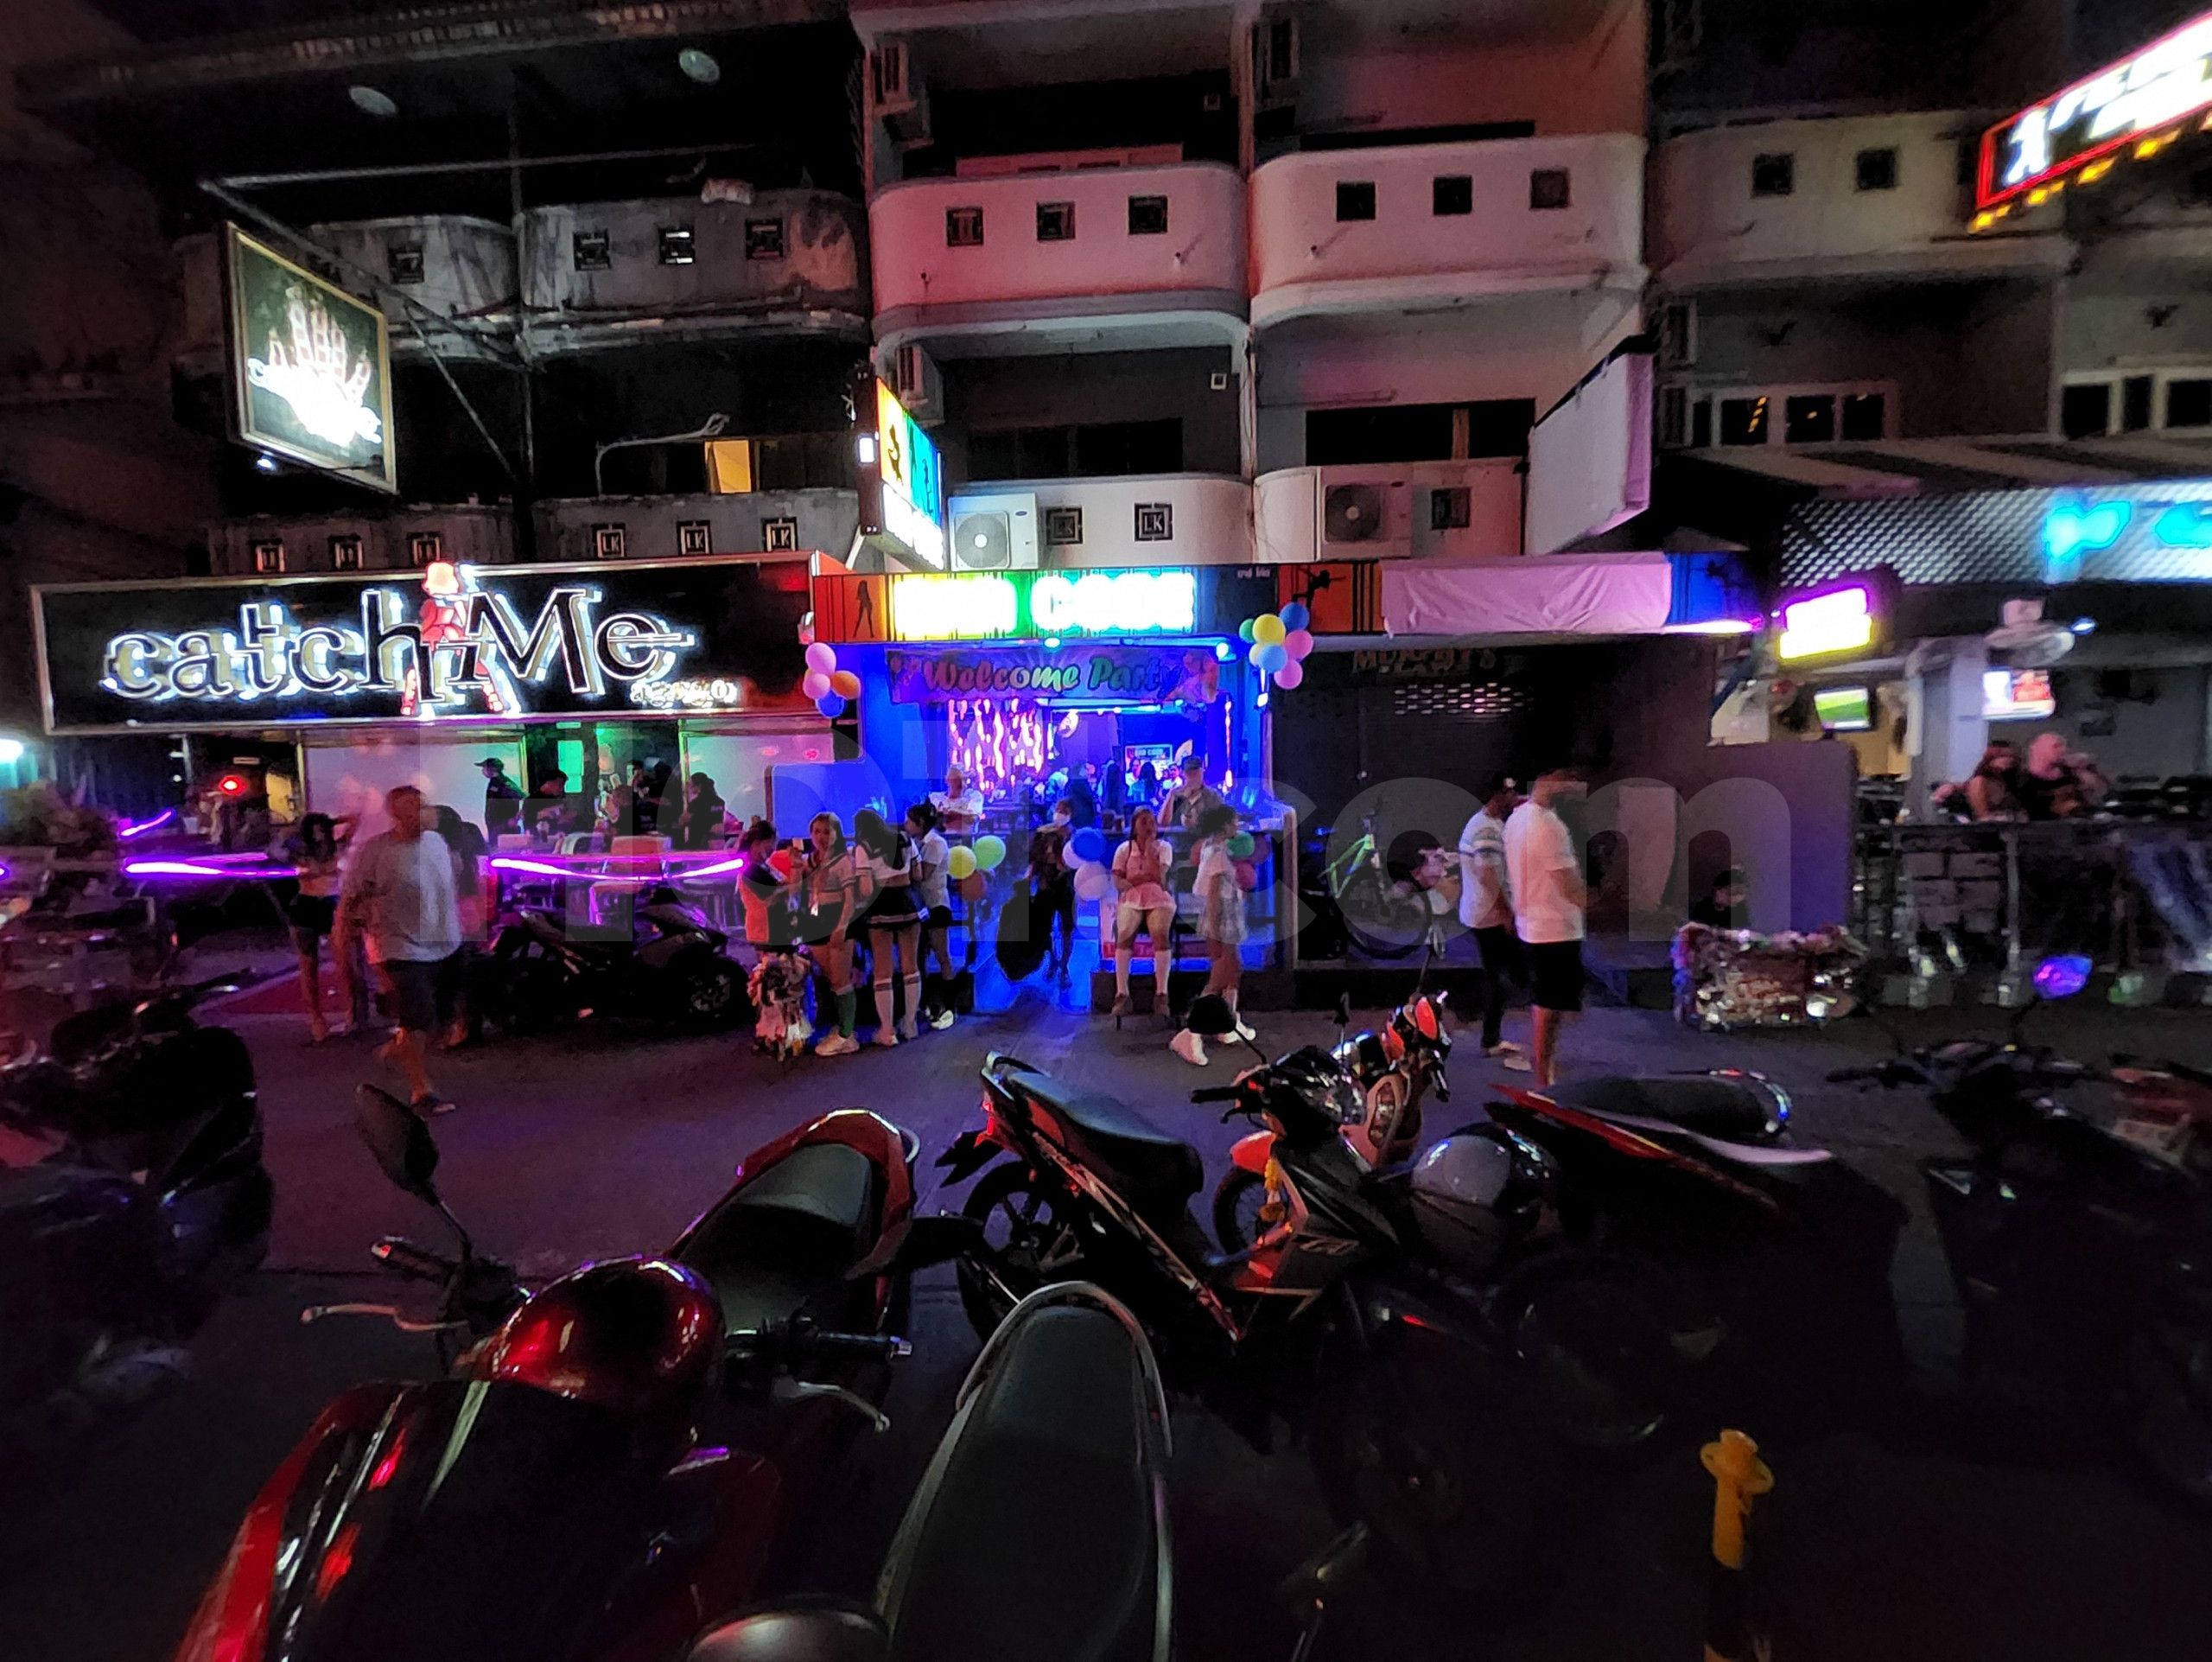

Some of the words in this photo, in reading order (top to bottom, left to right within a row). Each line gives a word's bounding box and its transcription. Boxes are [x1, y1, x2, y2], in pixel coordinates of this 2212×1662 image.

[1143, 514, 1163, 532] LK
[602, 533, 621, 551] LK
[687, 530, 704, 549] LK
[772, 527, 790, 545] LK
[107, 589, 444, 702] catch
[447, 589, 694, 694] Me
[923, 659, 1081, 692] Welcome
[1088, 656, 1182, 698] Party
